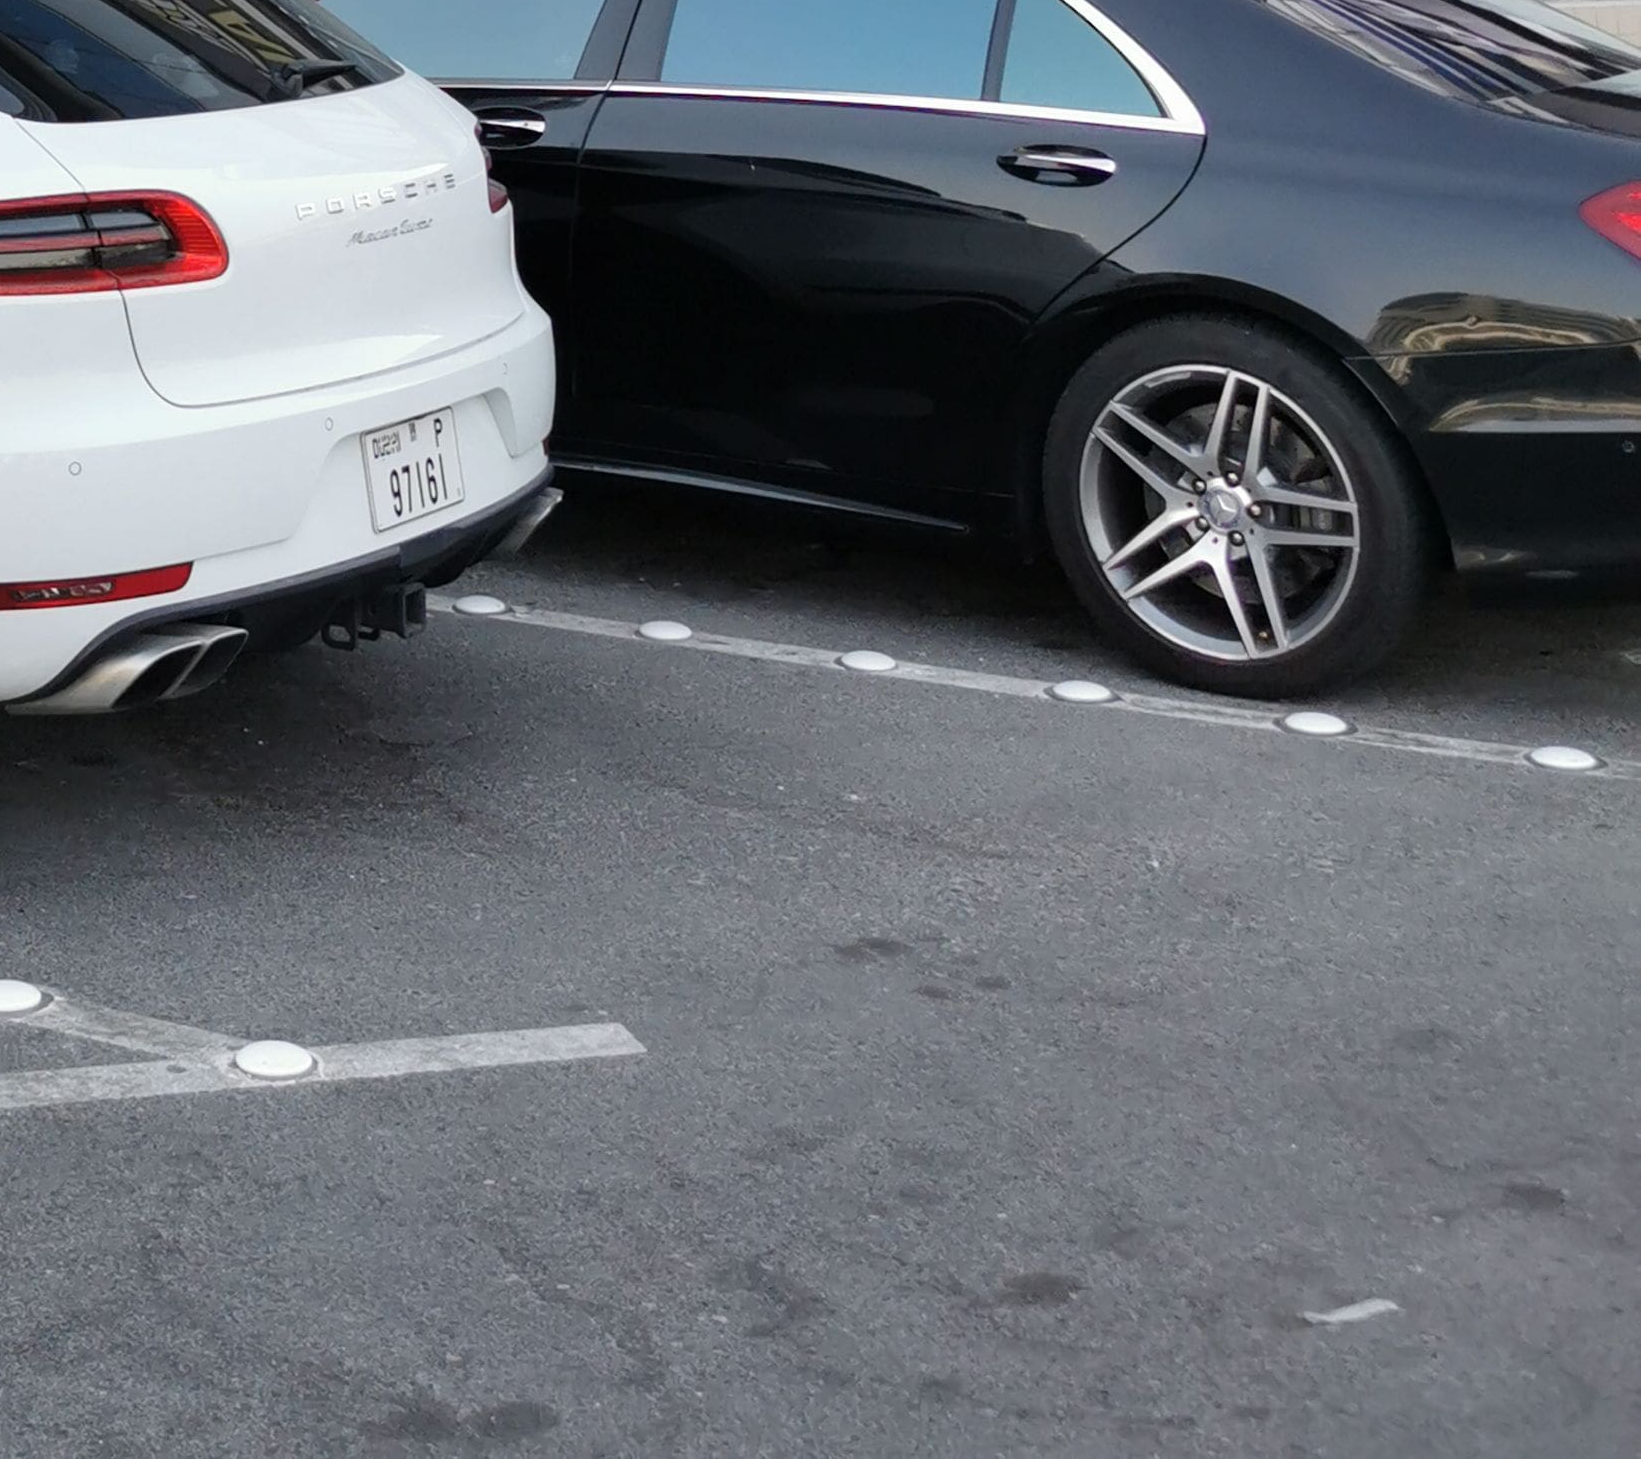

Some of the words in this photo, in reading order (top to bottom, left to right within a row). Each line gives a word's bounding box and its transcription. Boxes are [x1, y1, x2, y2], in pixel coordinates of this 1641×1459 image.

[295, 173, 456, 220] PORSCHE
[433, 418, 443, 448] P
[389, 453, 448, 517] 97161
